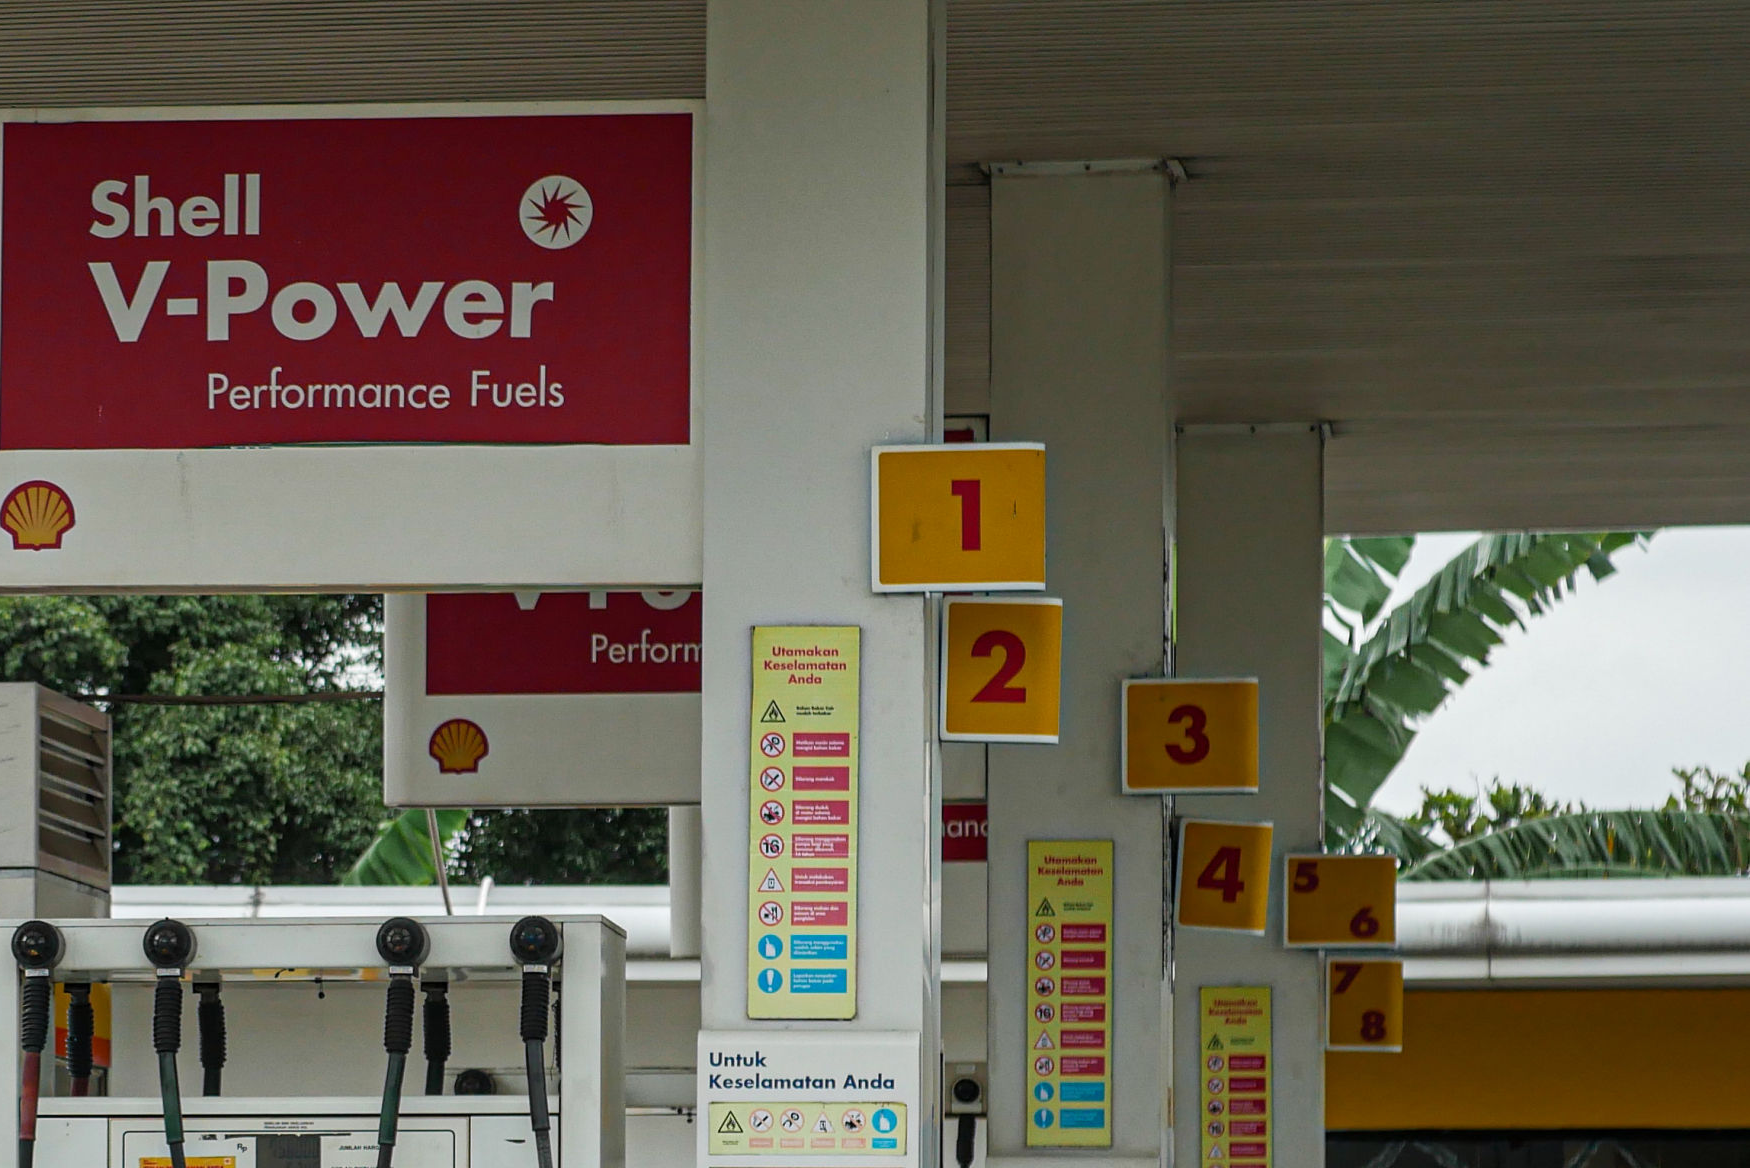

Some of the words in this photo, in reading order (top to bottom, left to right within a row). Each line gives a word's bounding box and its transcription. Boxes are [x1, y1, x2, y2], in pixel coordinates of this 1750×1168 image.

[88, 173, 261, 239] Shell
[88, 259, 555, 343] V-Power
[206, 367, 451, 410] Performance
[469, 365, 566, 408] Fuels
[951, 479, 982, 552] 1
[764, 660, 847, 671] Keselamatan
[772, 646, 839, 657] Utamakan
[970, 629, 1027, 704] 2
[787, 673, 822, 685] Anda
[1164, 705, 1210, 765] 3
[1197, 846, 1245, 904] 4
[1293, 862, 1319, 894] 5
[1350, 906, 1380, 938] 6
[1333, 964, 1361, 995] 7
[1360, 1010, 1387, 1042] 8
[708, 1051, 767, 1067] Untuk
[708, 1073, 836, 1090] Keselamatan
[843, 1073, 895, 1090] Anda
